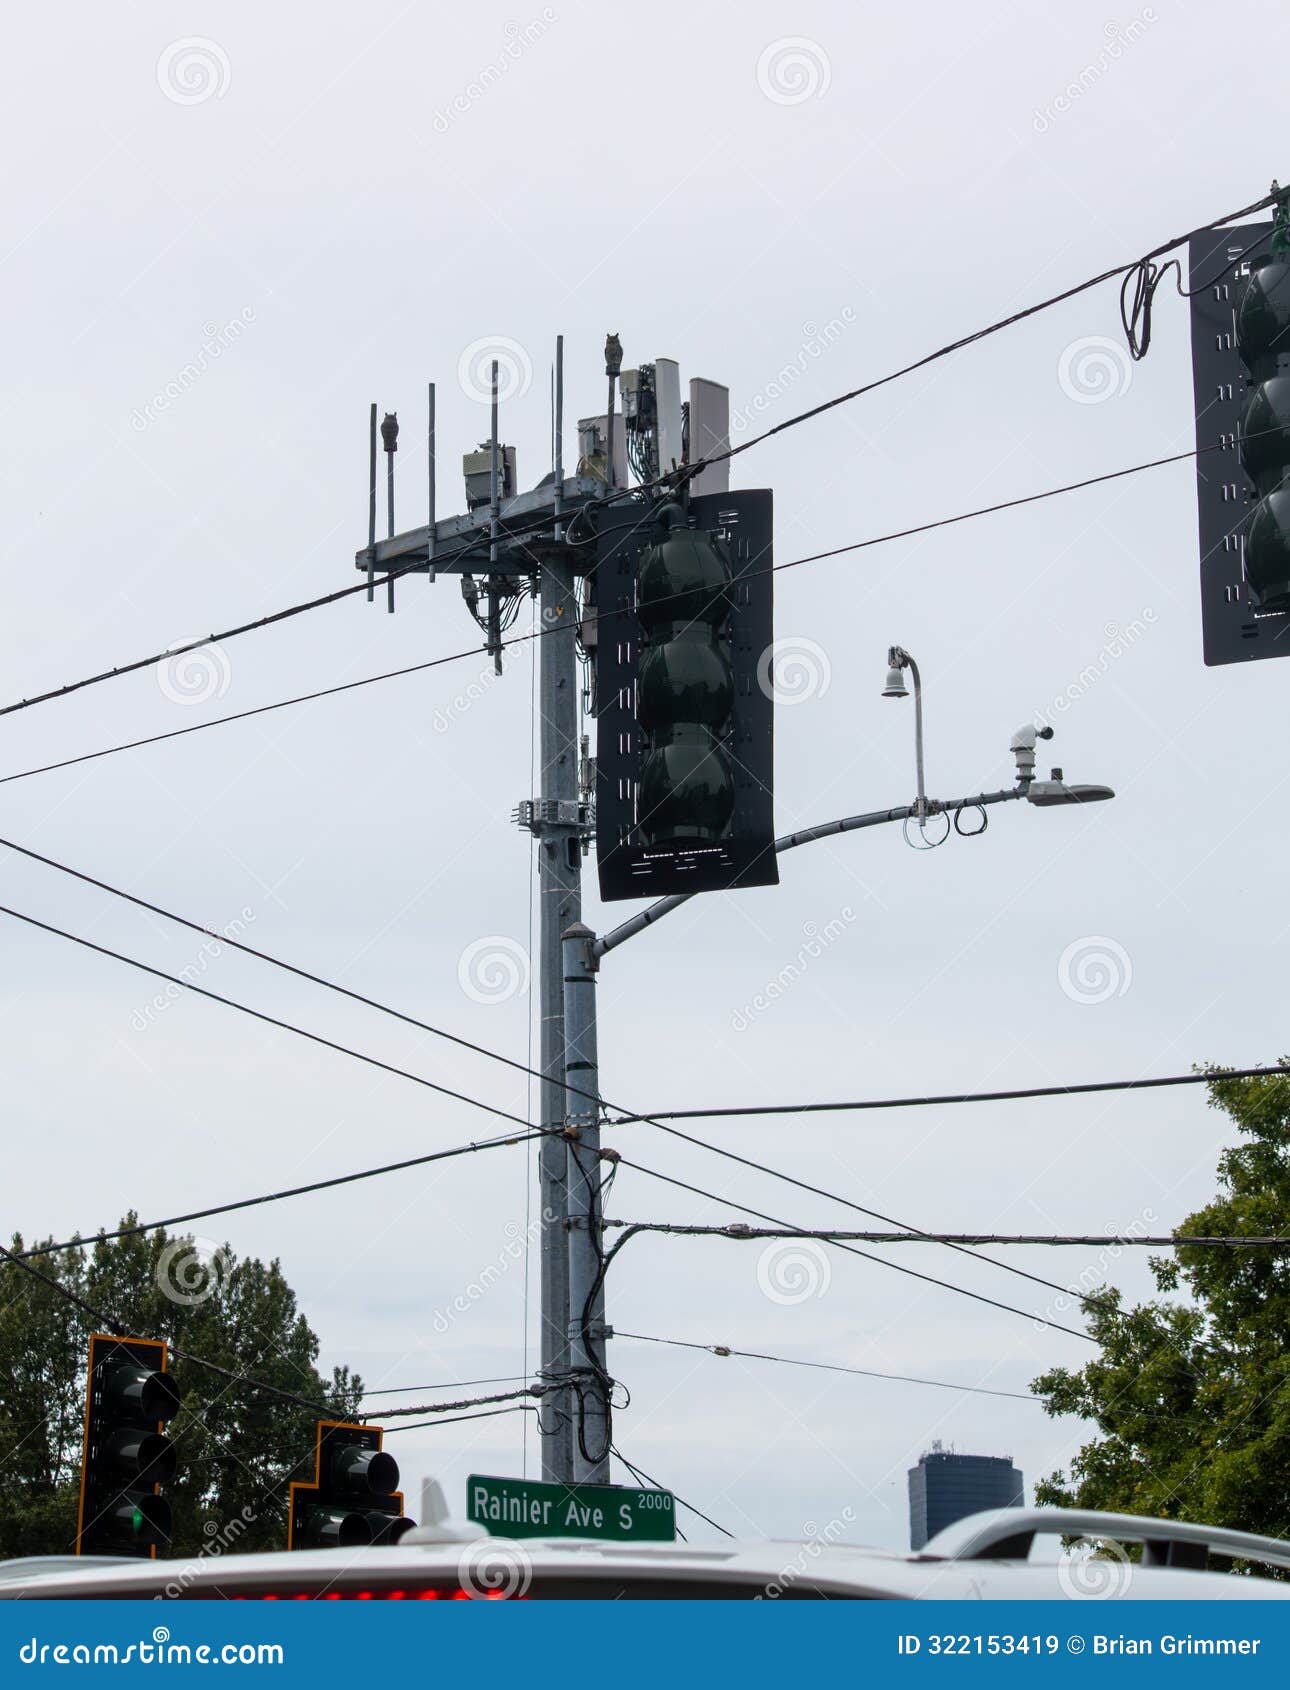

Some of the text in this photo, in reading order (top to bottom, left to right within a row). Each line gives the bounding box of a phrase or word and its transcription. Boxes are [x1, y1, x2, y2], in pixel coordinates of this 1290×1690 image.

[474, 1486, 633, 1530] Rainier Ave S
[638, 1493, 671, 1510] 2000
